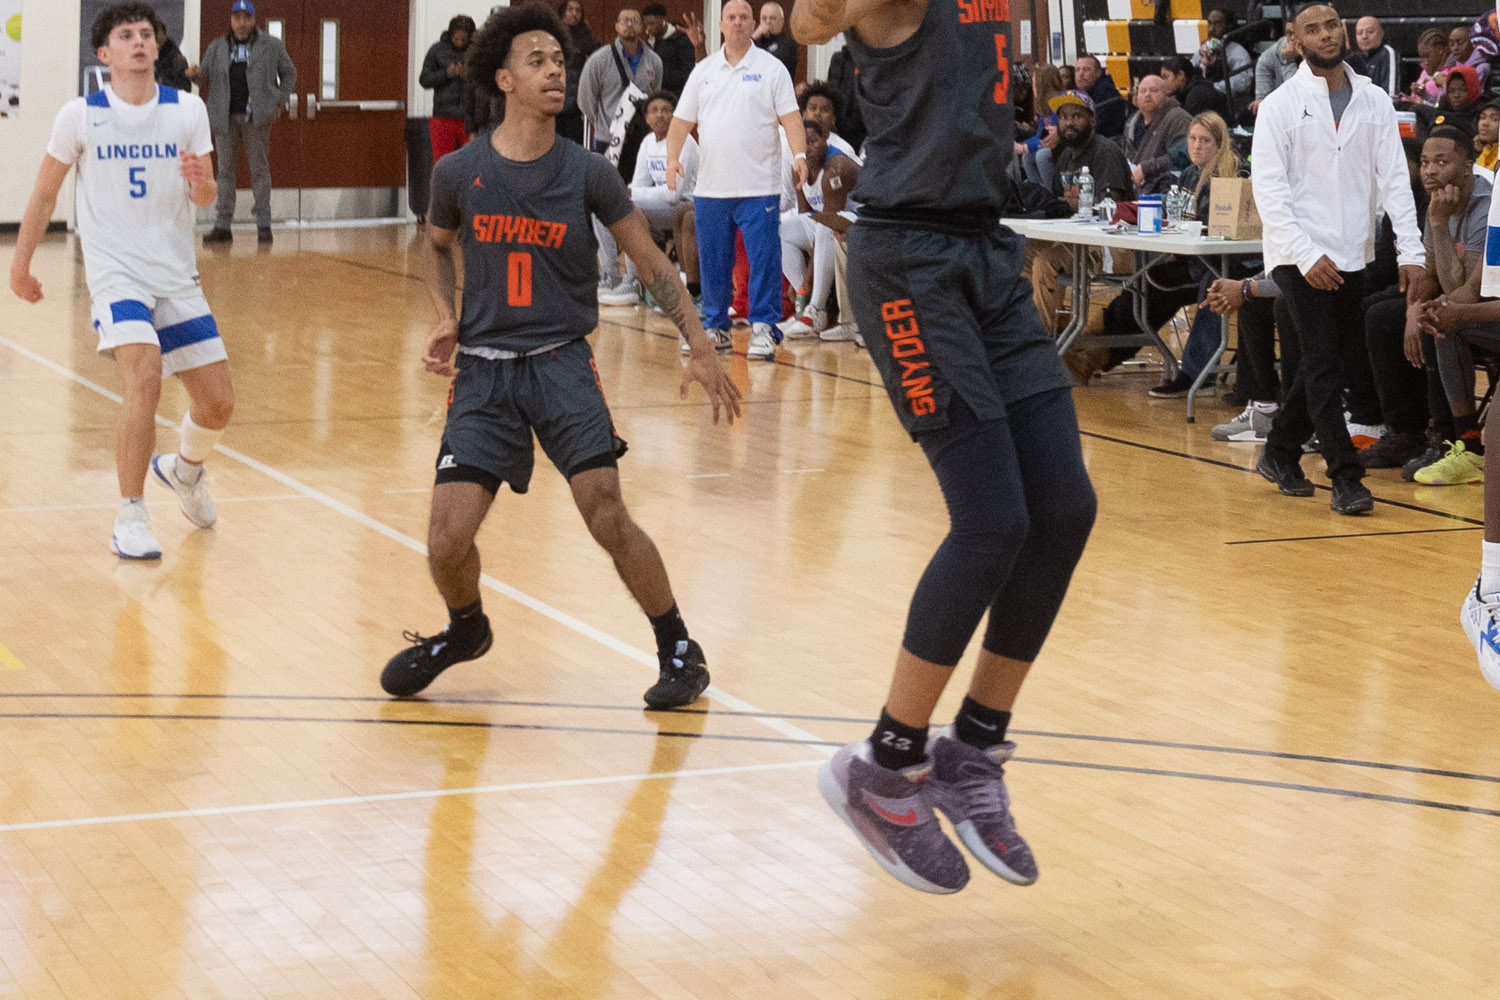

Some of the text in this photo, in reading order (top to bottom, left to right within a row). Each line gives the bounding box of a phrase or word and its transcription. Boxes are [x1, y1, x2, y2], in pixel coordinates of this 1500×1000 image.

[97, 143, 178, 160] LINCOLN
[128, 166, 147, 199] 5
[472, 213, 568, 250] SNYDER
[507, 252, 532, 307] 0
[881, 298, 937, 417] SNYDER
